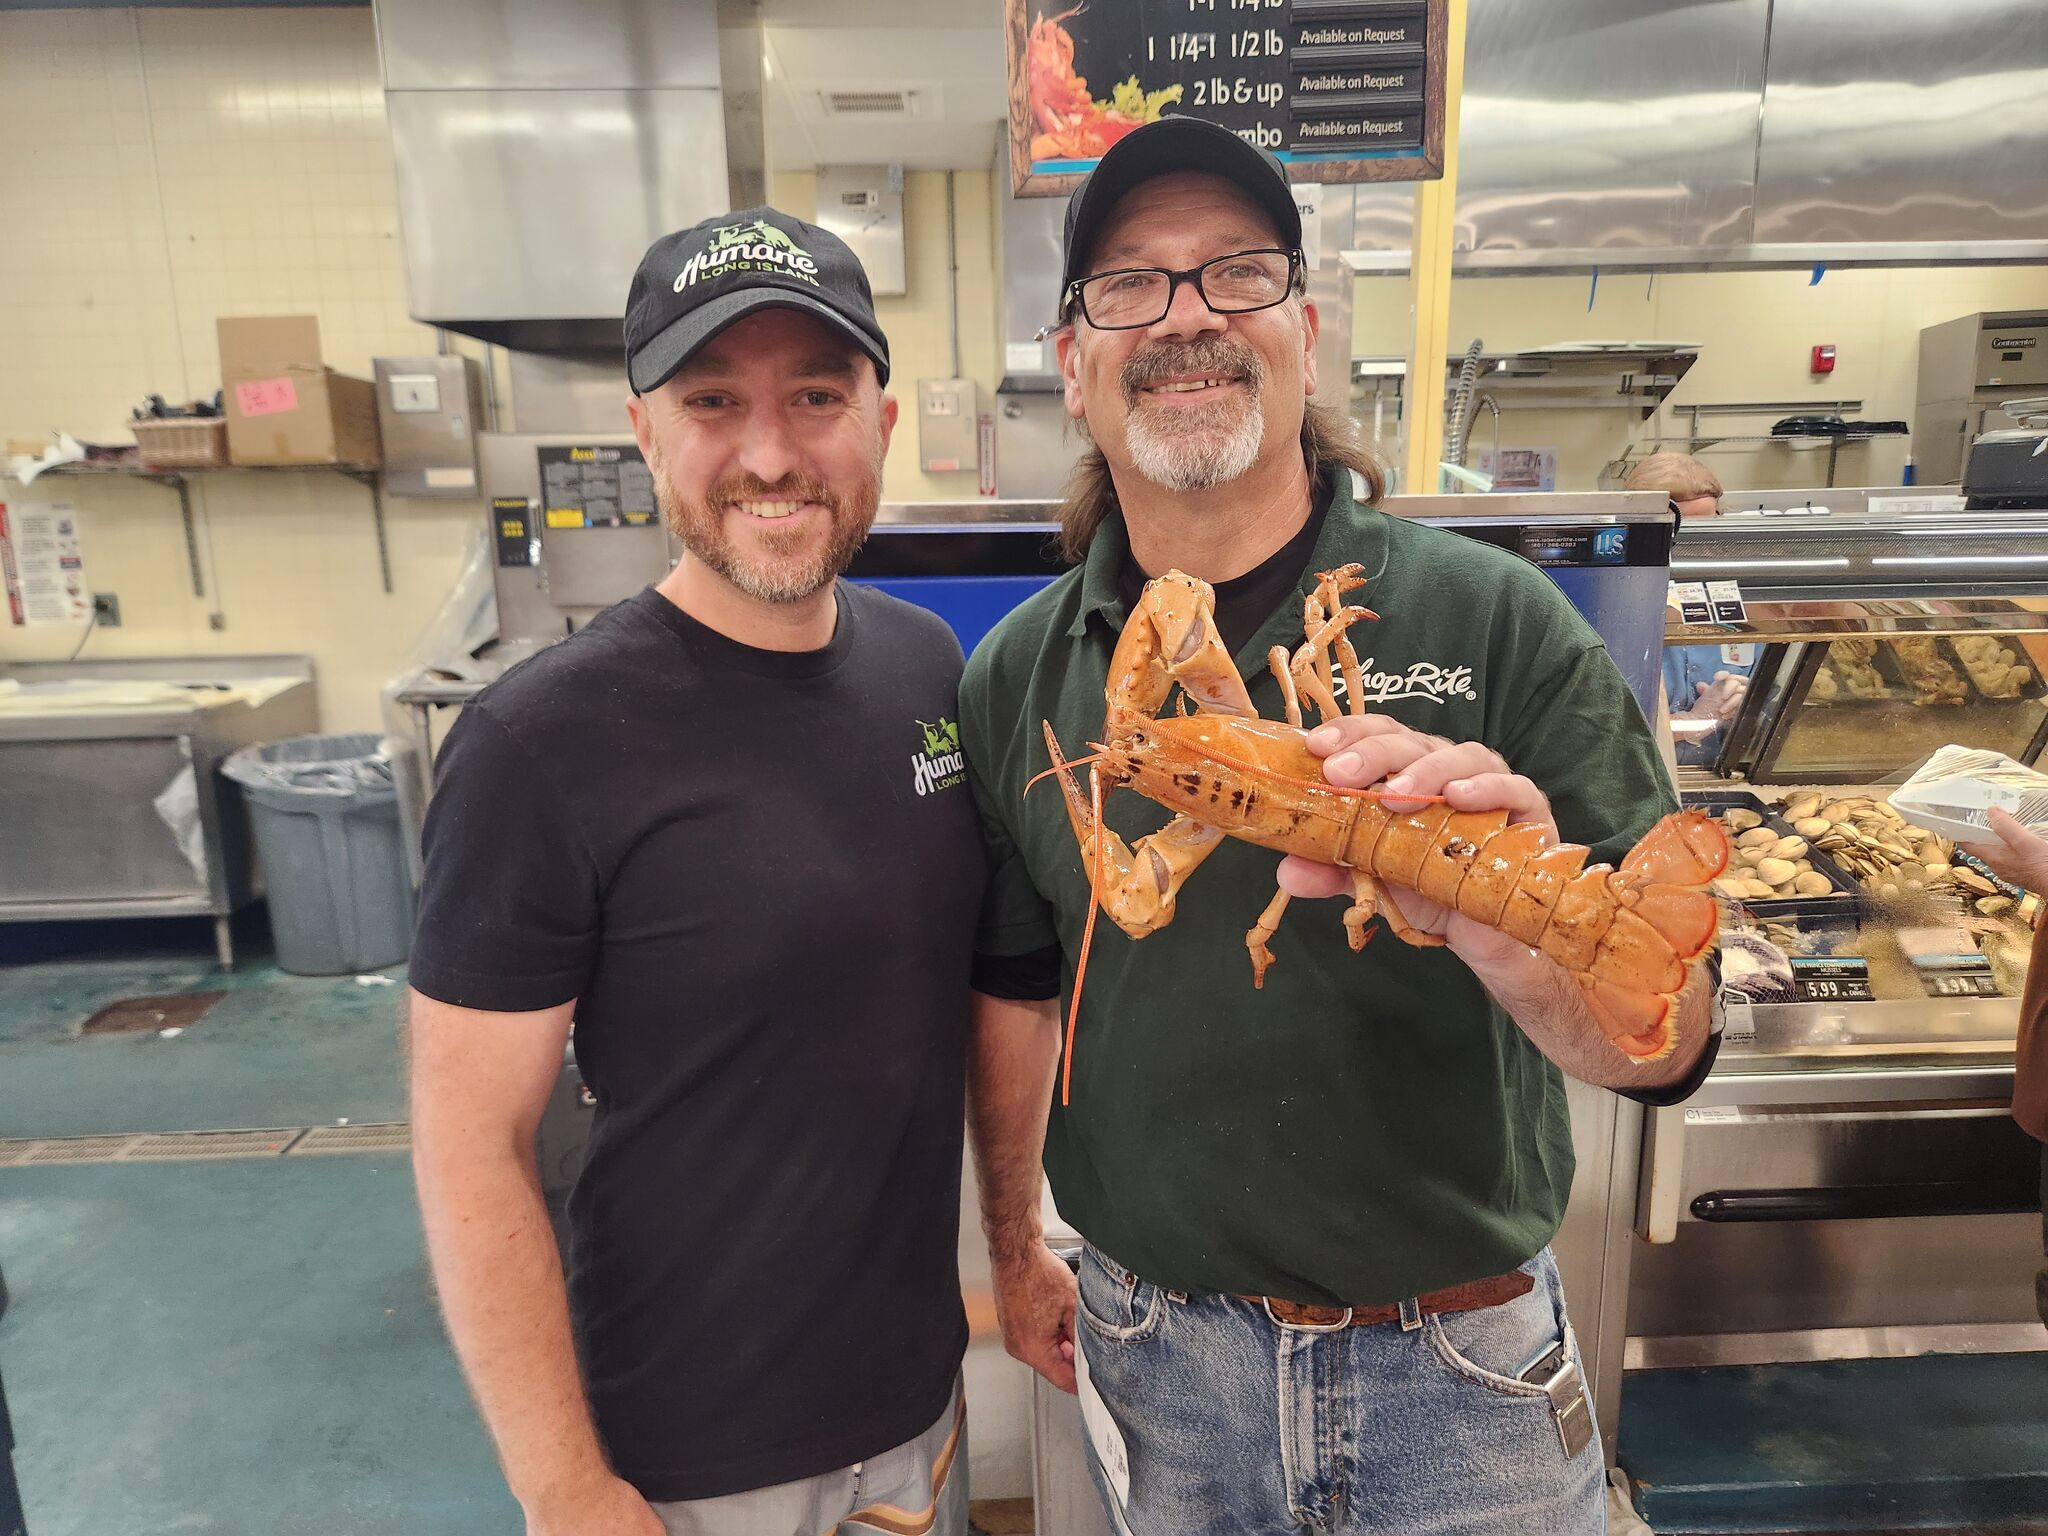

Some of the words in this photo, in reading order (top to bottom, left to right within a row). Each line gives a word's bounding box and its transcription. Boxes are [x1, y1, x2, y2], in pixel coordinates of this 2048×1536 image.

[1231, 29, 1260, 58] 1/2
[1264, 28, 1284, 56] lb
[1300, 29, 1347, 45] Available
[1348, 31, 1362, 43] on
[1364, 28, 1405, 45] Request
[1193, 80, 1207, 106] 2
[1210, 77, 1230, 105] lb
[1233, 77, 1253, 104] &
[1256, 82, 1284, 109] up
[1300, 75, 1346, 91] Available
[1347, 78, 1361, 89] on
[1363, 74, 1404, 91] Request
[1231, 121, 1283, 147] mbo
[1299, 121, 1346, 137] Available
[1346, 124, 1360, 136] on
[1362, 120, 1404, 137] Request
[672, 243, 819, 294] Humane
[701, 261, 751, 281] LONG
[756, 261, 820, 287] ISLAND
[911, 752, 964, 796] Huma
[936, 775, 960, 790] LONG
[1808, 981, 1838, 997] 5.99
